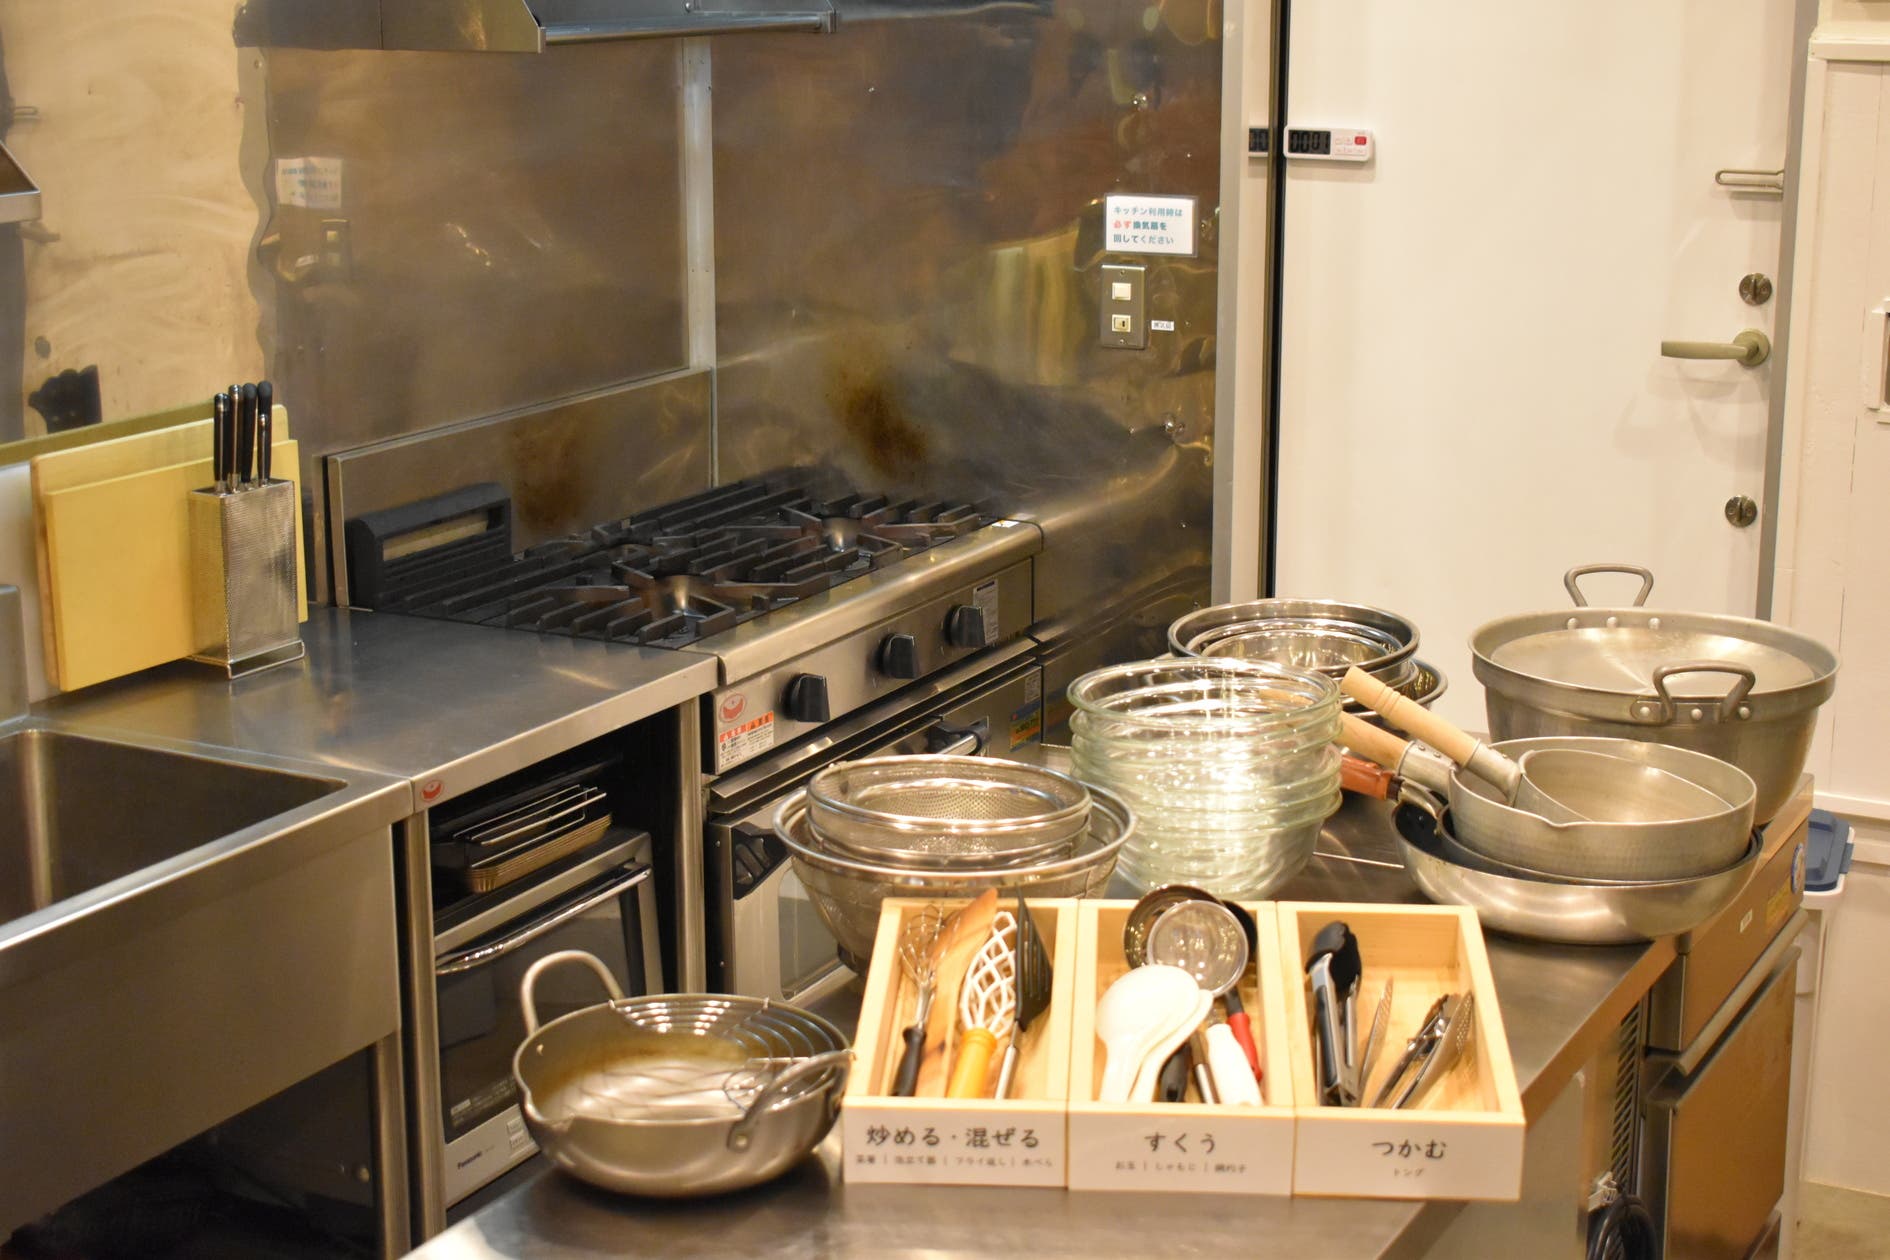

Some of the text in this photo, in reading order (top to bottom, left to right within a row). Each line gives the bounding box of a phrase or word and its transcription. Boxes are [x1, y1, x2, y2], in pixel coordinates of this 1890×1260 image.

[1113, 233, 1175, 245] 回してください
[1144, 1132, 1216, 1154] すくう
[1372, 1139, 1448, 1160] つかむ
